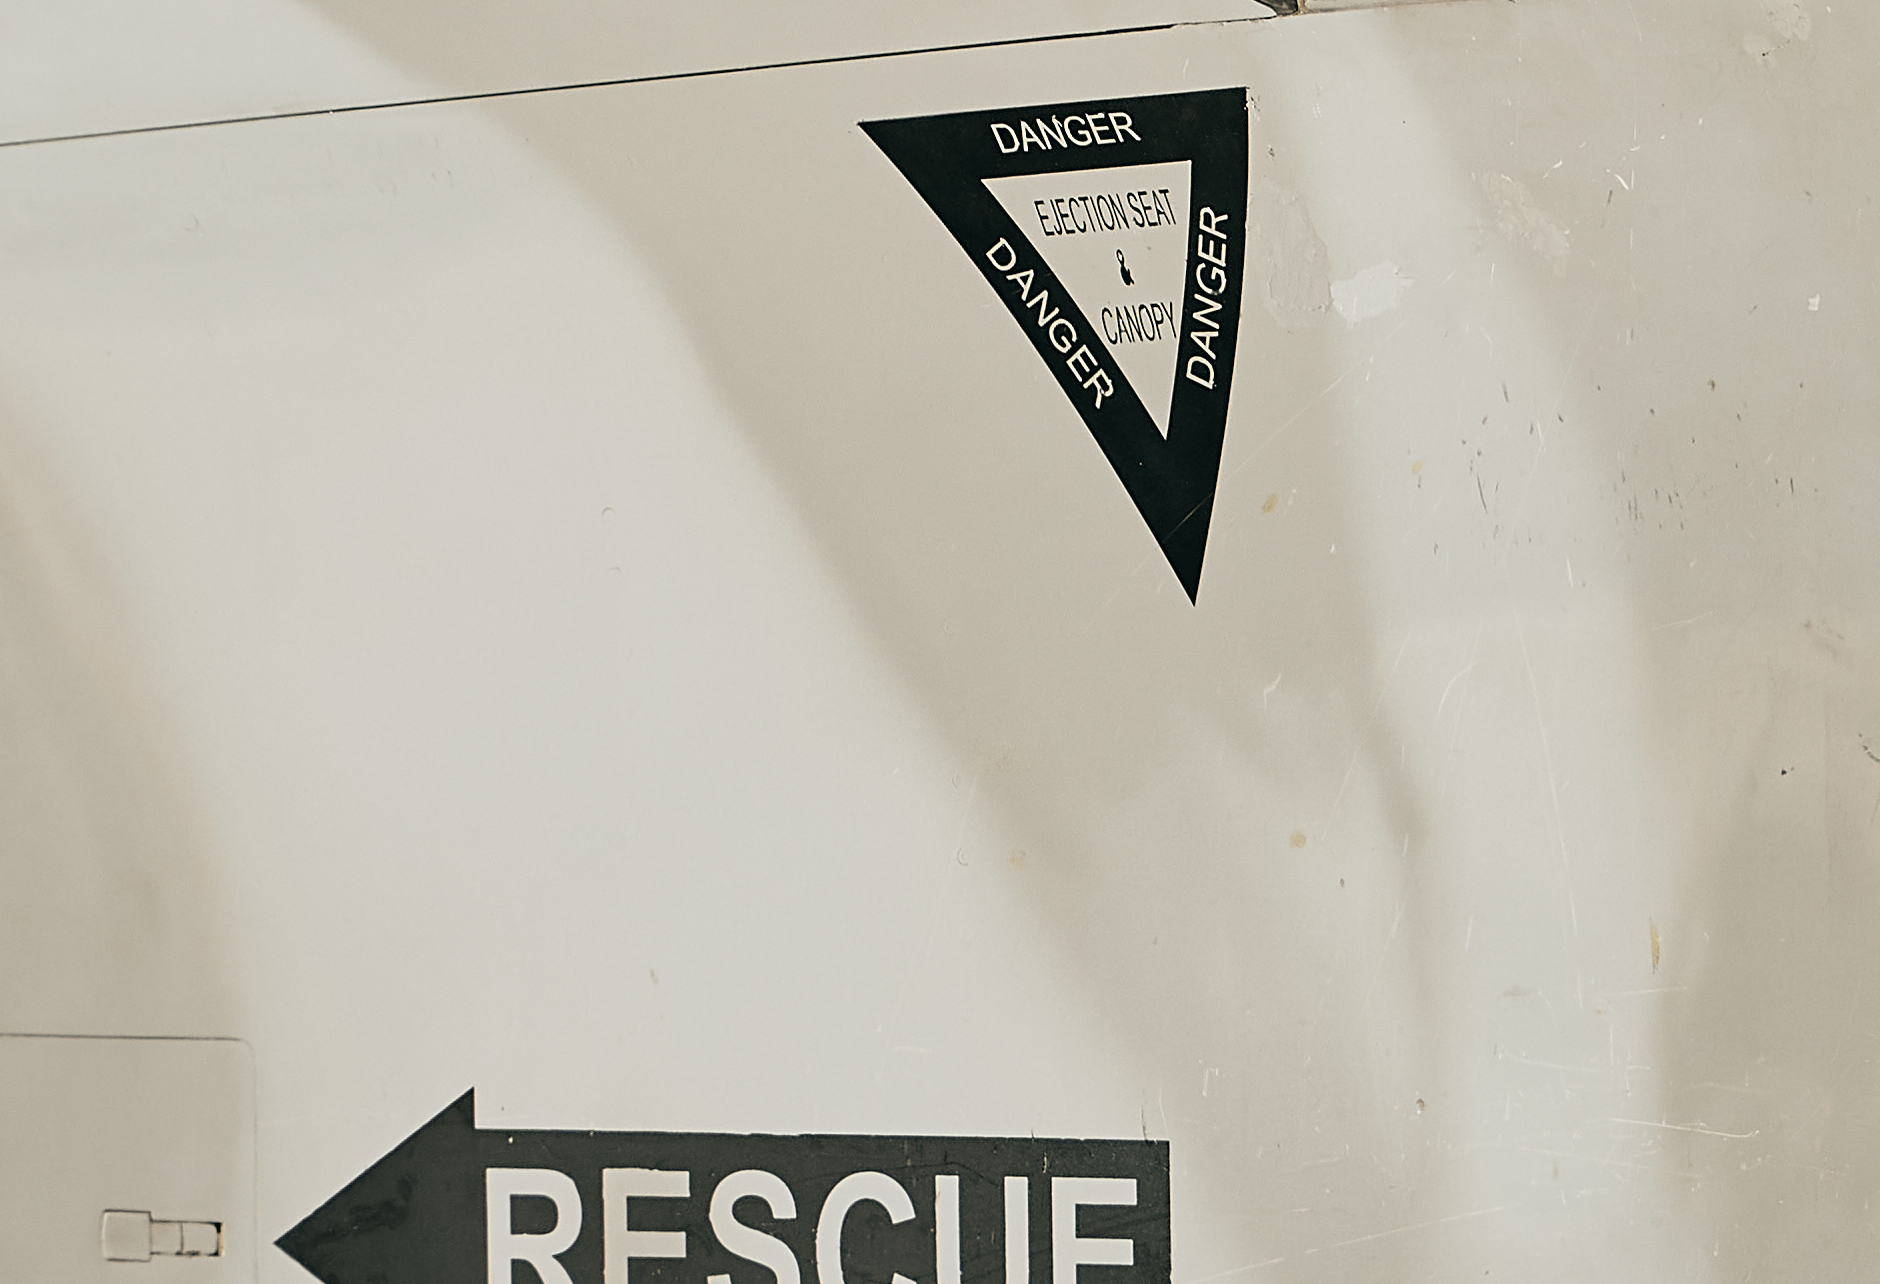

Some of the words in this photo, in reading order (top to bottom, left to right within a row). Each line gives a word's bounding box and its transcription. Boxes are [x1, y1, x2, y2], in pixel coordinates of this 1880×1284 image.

[990, 111, 1142, 155] DANGER
[1033, 192, 1131, 237] EJECTION
[1130, 188, 1178, 229] SEAT
[1117, 248, 1135, 287] &
[986, 236, 1115, 410] DANGER
[1101, 300, 1180, 346] CANOPY
[1186, 206, 1230, 391] DANGER
[486, 1164, 1138, 1284] RESCUE
